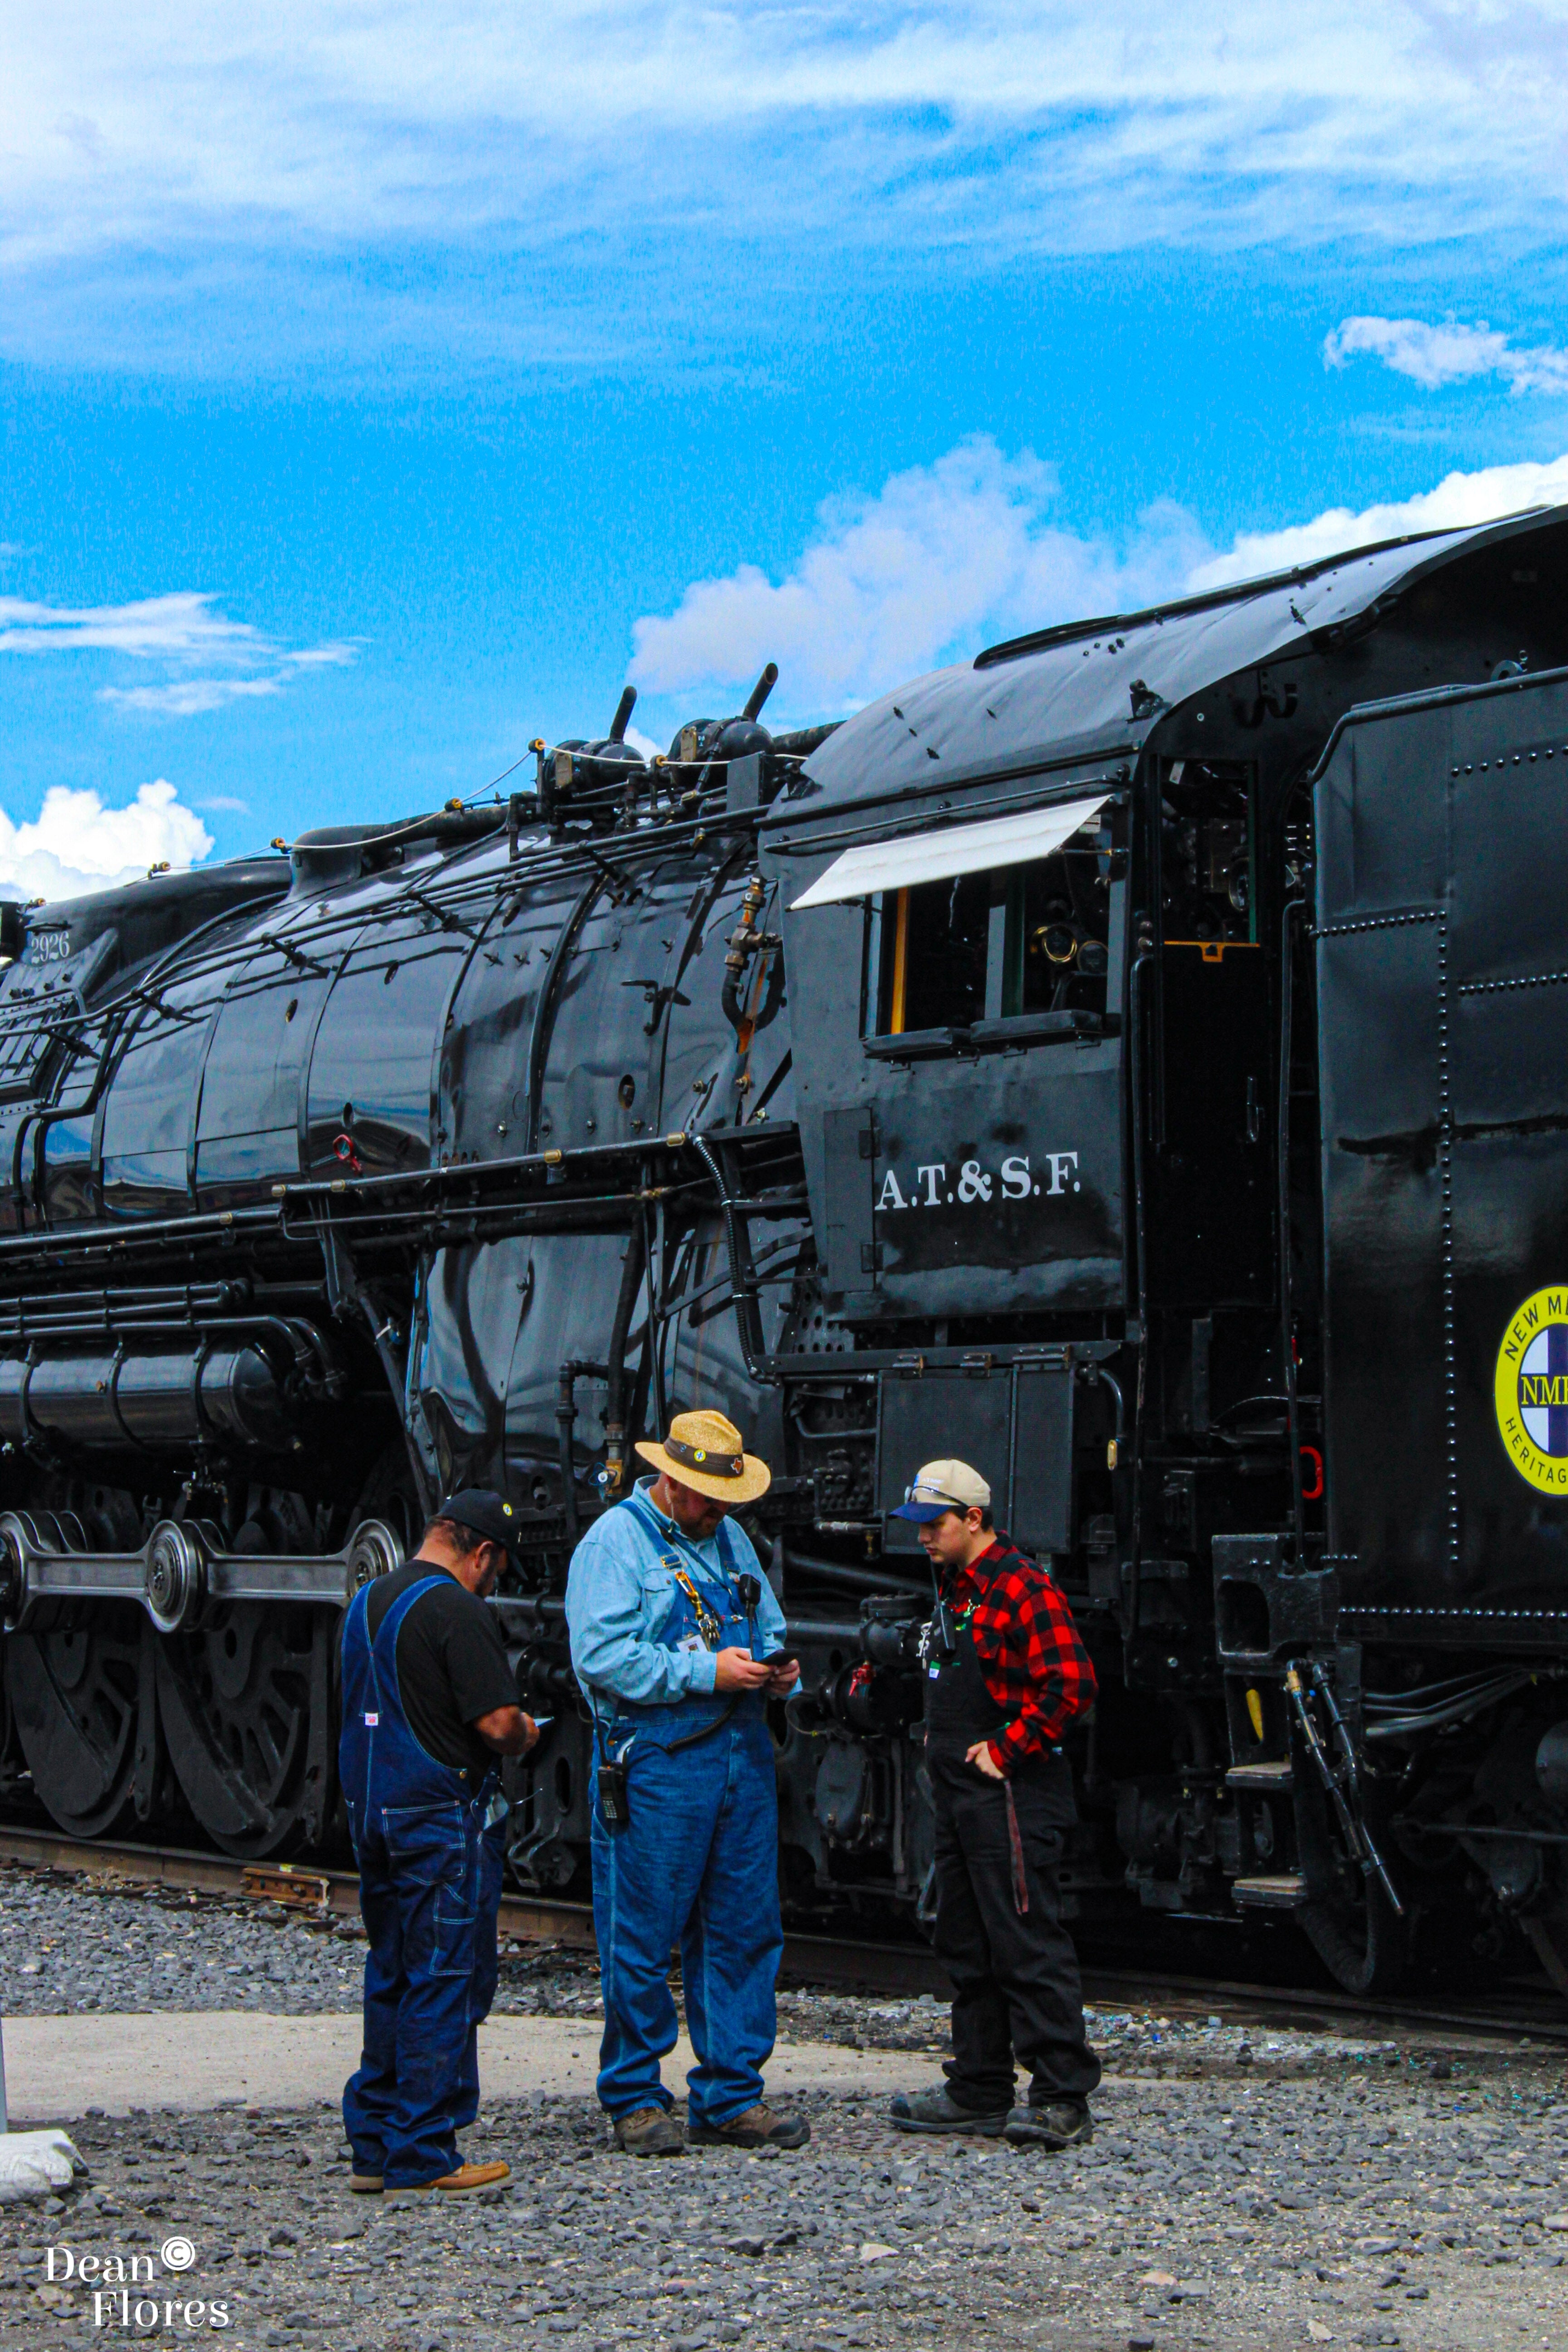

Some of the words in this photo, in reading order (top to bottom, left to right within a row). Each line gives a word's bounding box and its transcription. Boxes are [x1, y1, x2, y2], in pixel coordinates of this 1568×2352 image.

[31, 931, 70, 964] 2926
[874, 1151, 1081, 1211] A.T.&S.F.
[1504, 1302, 1539, 1361] NEW
